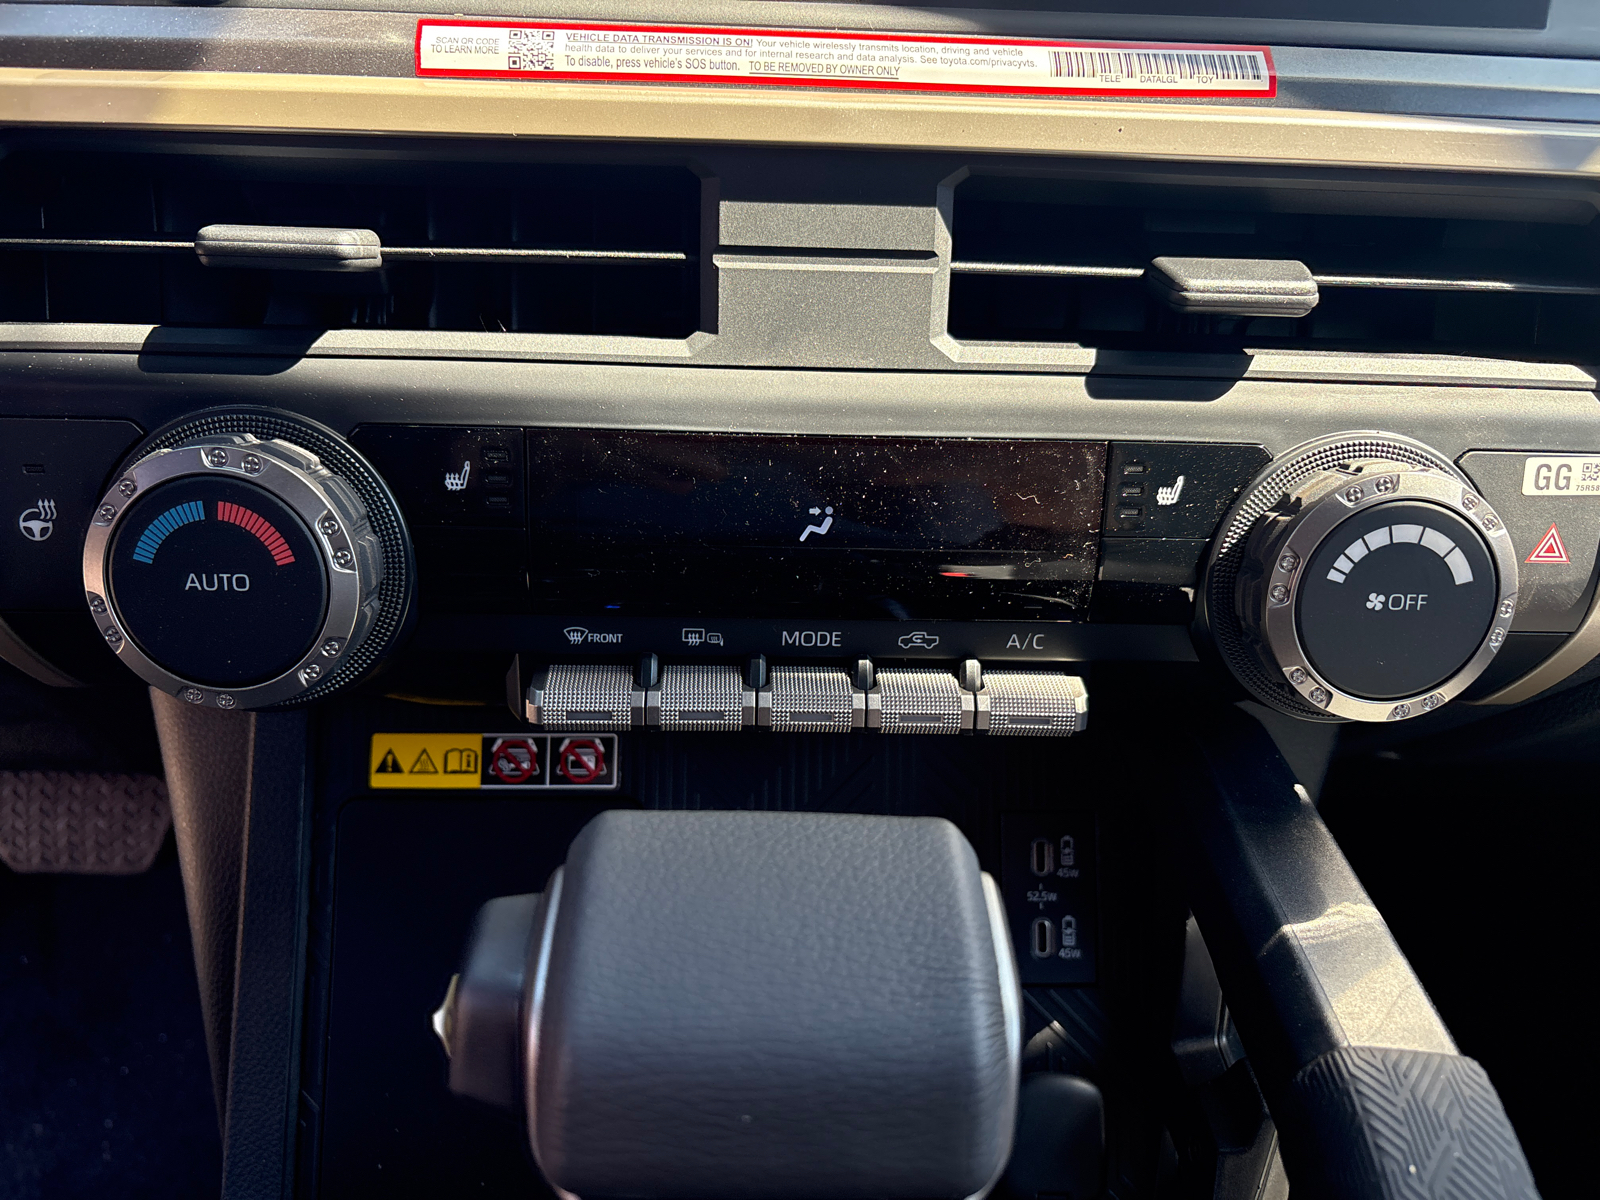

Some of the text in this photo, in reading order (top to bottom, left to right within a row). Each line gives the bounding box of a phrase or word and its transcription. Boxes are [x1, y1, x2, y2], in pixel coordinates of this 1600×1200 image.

[435, 36, 500, 46] SCAN QR CODE
[565, 32, 610, 42] VEHICLE
[613, 34, 640, 43] DATA
[642, 35, 720, 45] TRANSMISSION
[722, 37, 732, 46] IS
[756, 38, 776, 48] Your
[778, 40, 811, 49] vehicle
[812, 41, 857, 52] wirelessly
[859, 43, 900, 53] transmits
[901, 44, 940, 55] location,
[941, 46, 971, 56] driving
[992, 48, 1024, 57] vehicle
[431, 44, 500, 55] TO LEARN MORE
[564, 43, 592, 52] health
[595, 45, 615, 53] data
[618, 45, 627, 53] to
[630, 46, 660, 54] deliver
[662, 47, 682, 57] your
[685, 48, 723, 56] services
[725, 49, 742, 57] and
[745, 49, 757, 58] for
[759, 49, 793, 59] internal
[795, 51, 835, 60] research
[836, 53, 854, 61] and
[856, 53, 876, 62] data
[878, 55, 918, 65] analysis.
[919, 56, 938, 64] See
[565, 54, 901, 76] To disable, press vehicle's SOS button. TO BE REMOVED BY OWNER ONLY
[1099, 74, 1214, 84] TELE DATALGL TOY
[1533, 463, 1572, 491] GG
[185, 573, 250, 592] AUTO
[1387, 594, 1428, 611] OFF
[588, 633, 623, 643] FRONT
[782, 631, 842, 647] MODE
[1005, 632, 1045, 650] A/C
[1056, 867, 1080, 879] 45W
[1026, 890, 1058, 902] 52.5W
[1058, 947, 1082, 960] 45W
